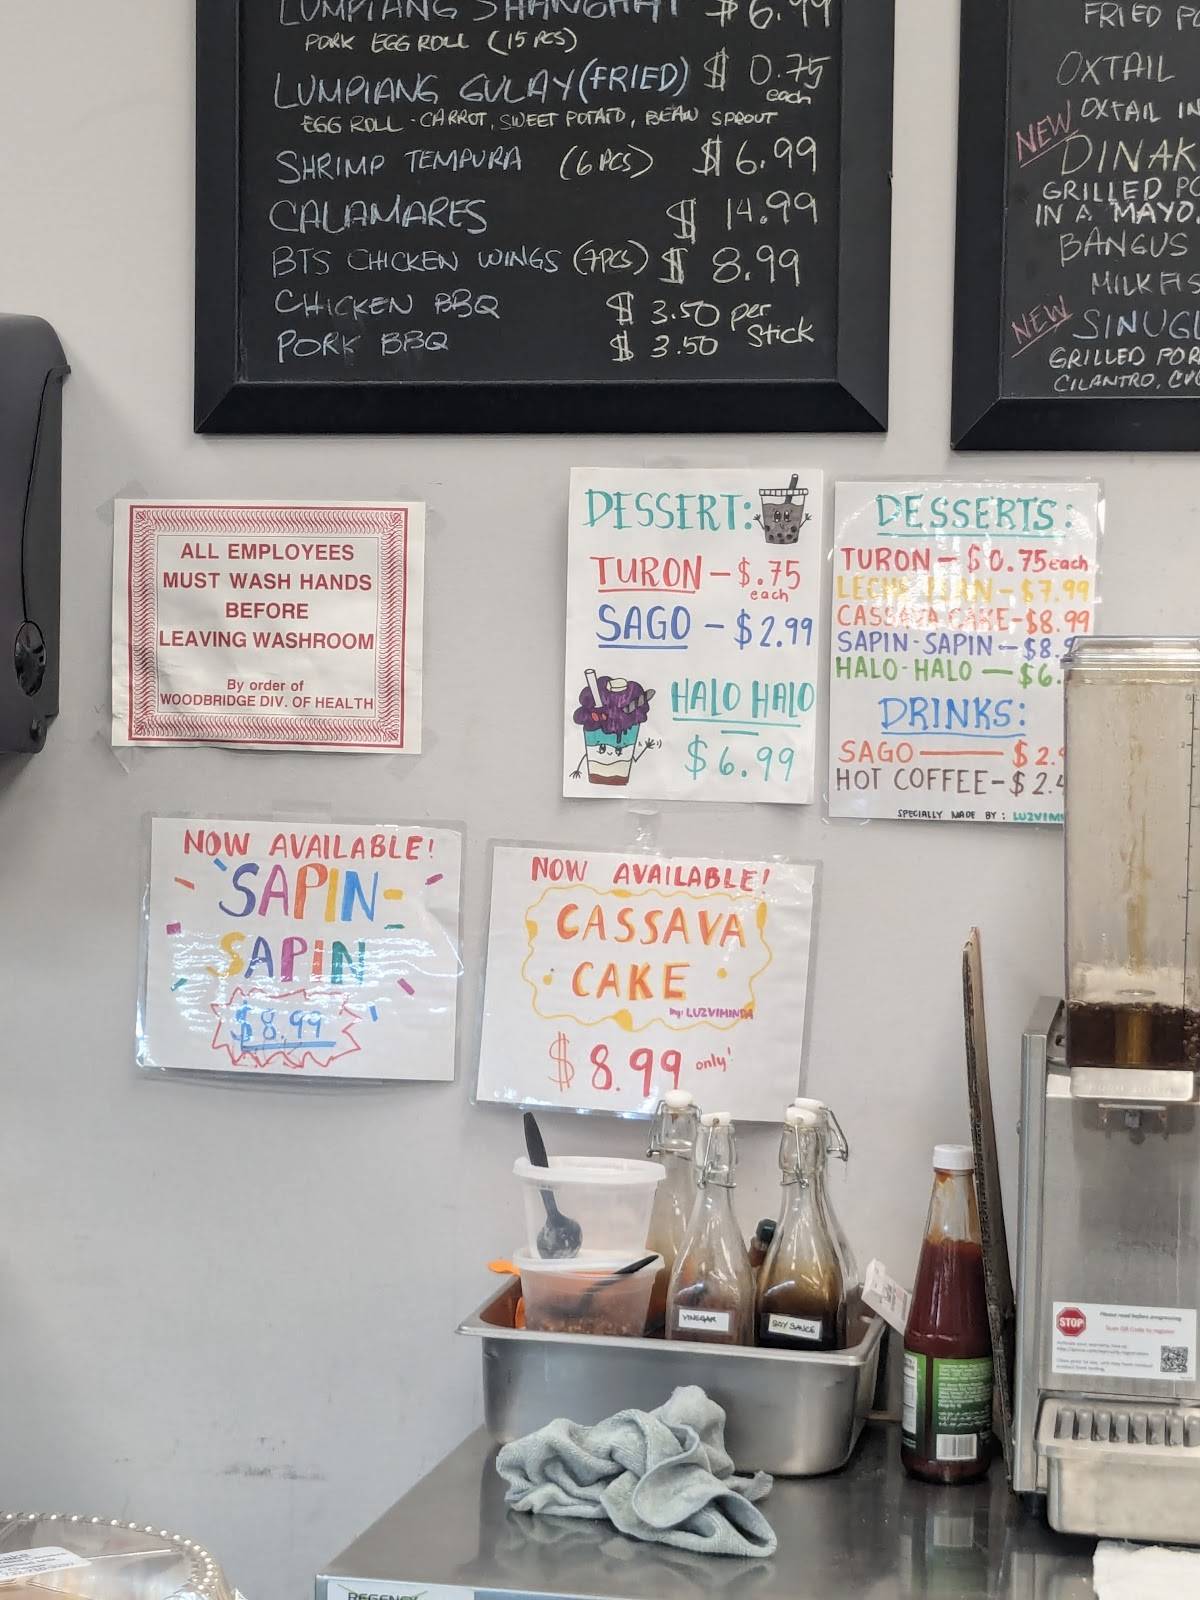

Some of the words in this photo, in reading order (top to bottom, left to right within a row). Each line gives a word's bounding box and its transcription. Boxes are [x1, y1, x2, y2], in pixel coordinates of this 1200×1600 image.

[281, 0, 457, 26] LUMPIANG
[473, 0, 679, 24] SHANGHAI
[1084, 2, 1162, 29] FRIED
[305, 33, 356, 51] PORK
[371, 33, 410, 52] EGG
[418, 32, 470, 51] ROLL
[1056, 51, 1175, 86] OXTAIL
[274, 72, 439, 109] LUMPIANG
[766, 88, 811, 105] each
[301, 115, 342, 133] EGG
[350, 115, 404, 133] ROLL
[500, 112, 559, 130] SWEET
[645, 105, 699, 126] BEAN
[711, 111, 779, 126] SPROUT
[1081, 97, 1161, 122] OXTAIL
[1016, 100, 1071, 162] NEW
[276, 150, 385, 184] SHRIMP
[404, 145, 523, 173] TEMPURA
[1061, 134, 1196, 176] DINAK
[1043, 176, 1162, 202] GRILLED
[269, 194, 488, 234] CALAMARES
[1035, 203, 1064, 227] IN
[1075, 203, 1093, 223] A
[272, 246, 331, 278] BTS
[347, 249, 459, 272] CHICKEN
[478, 245, 562, 273] WINGS
[1060, 226, 1188, 267] BANGUS
[274, 289, 413, 320] CHICKEN
[434, 289, 500, 319] BBQ
[731, 302, 772, 331] per
[1011, 295, 1070, 345] NEW
[277, 329, 361, 363] PORK
[381, 330, 448, 356] BBQ
[1049, 346, 1145, 369] GRILLED
[582, 488, 752, 531] DESSERT:
[875, 494, 1073, 532] DESSERTS:
[180, 543, 219, 560] ALL
[228, 543, 354, 561] EMPLOYEES
[841, 547, 931, 572] TURON
[163, 572, 220, 589] MUST
[230, 572, 291, 590] WASH
[300, 574, 372, 591] HANDS
[589, 555, 702, 590] TURON
[737, 557, 801, 591] $.75
[750, 589, 789, 602] each
[1020, 579, 1090, 605] $7.99
[226, 602, 308, 619] BEFORE
[159, 630, 247, 648] LEAVING
[252, 632, 374, 650] WASHROOM
[595, 604, 691, 642] SAGO
[734, 608, 813, 650] $2.99
[227, 678, 244, 691] By
[250, 680, 285, 691] order
[291, 680, 304, 691] of
[671, 678, 741, 716] HALO
[751, 680, 815, 719] HALO
[160, 693, 255, 707] WOODBRIDGE
[260, 695, 287, 707] DIV.
[292, 697, 311, 708] OF
[315, 697, 373, 710] HEALTH
[878, 697, 1026, 730] DRINKS:
[838, 740, 913, 764] SAGO
[836, 768, 882, 792] HOT
[893, 768, 989, 795] COFFEE
[897, 809, 943, 820] SPECIALLY
[951, 811, 976, 820] MADE
[1013, 812, 1064, 824] LUZVIM
[183, 829, 250, 856] NOW
[269, 832, 434, 861] AVAILABLE!
[531, 856, 588, 882] NOW
[613, 862, 771, 895] AVAILABLE!
[556, 903, 747, 949] CASSAVA
[206, 931, 367, 986] SAPIN
[571, 960, 690, 1001] CAKE
[230, 999, 322, 1044] $8.99
[1059, 1316, 1085, 1329] STOP
